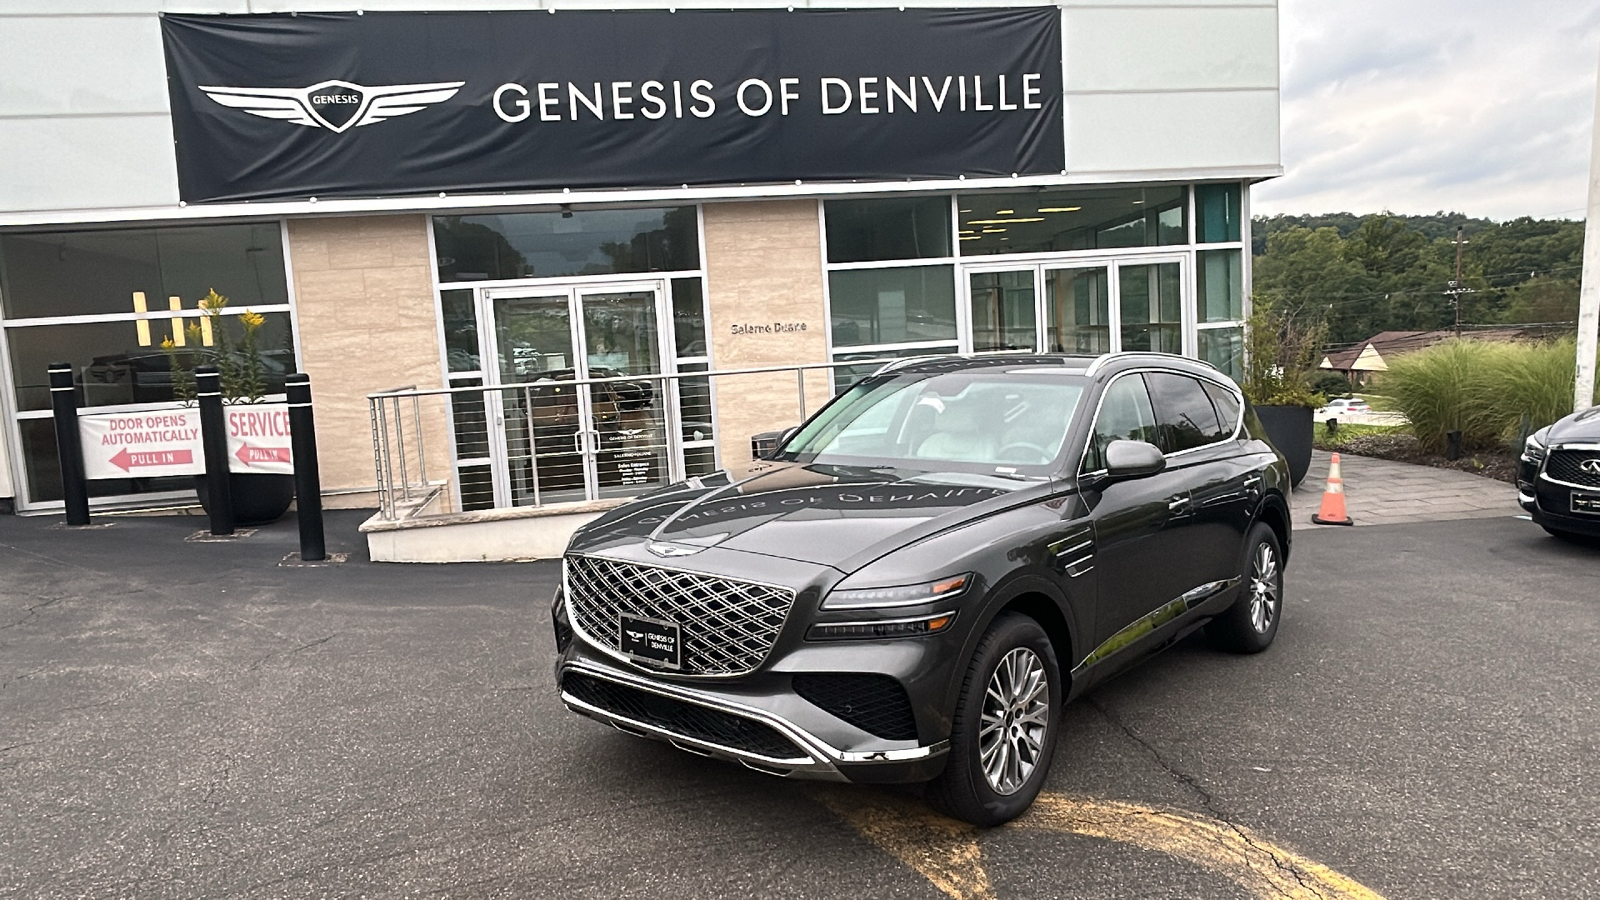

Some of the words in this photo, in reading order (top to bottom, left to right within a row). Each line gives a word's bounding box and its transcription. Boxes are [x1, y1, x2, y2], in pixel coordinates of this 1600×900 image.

[312, 94, 359, 104] GENESIS
[492, 79, 717, 124] GENESIS
[736, 77, 800, 117] OF
[820, 73, 1042, 115] DENVILLE
[109, 418, 143, 431] DOOR
[146, 414, 187, 429] OPENS
[229, 411, 291, 437] SERVICE
[101, 428, 198, 446] AUTOMATICALLY
[131, 454, 159, 465] PULL
[162, 452, 174, 463] IN
